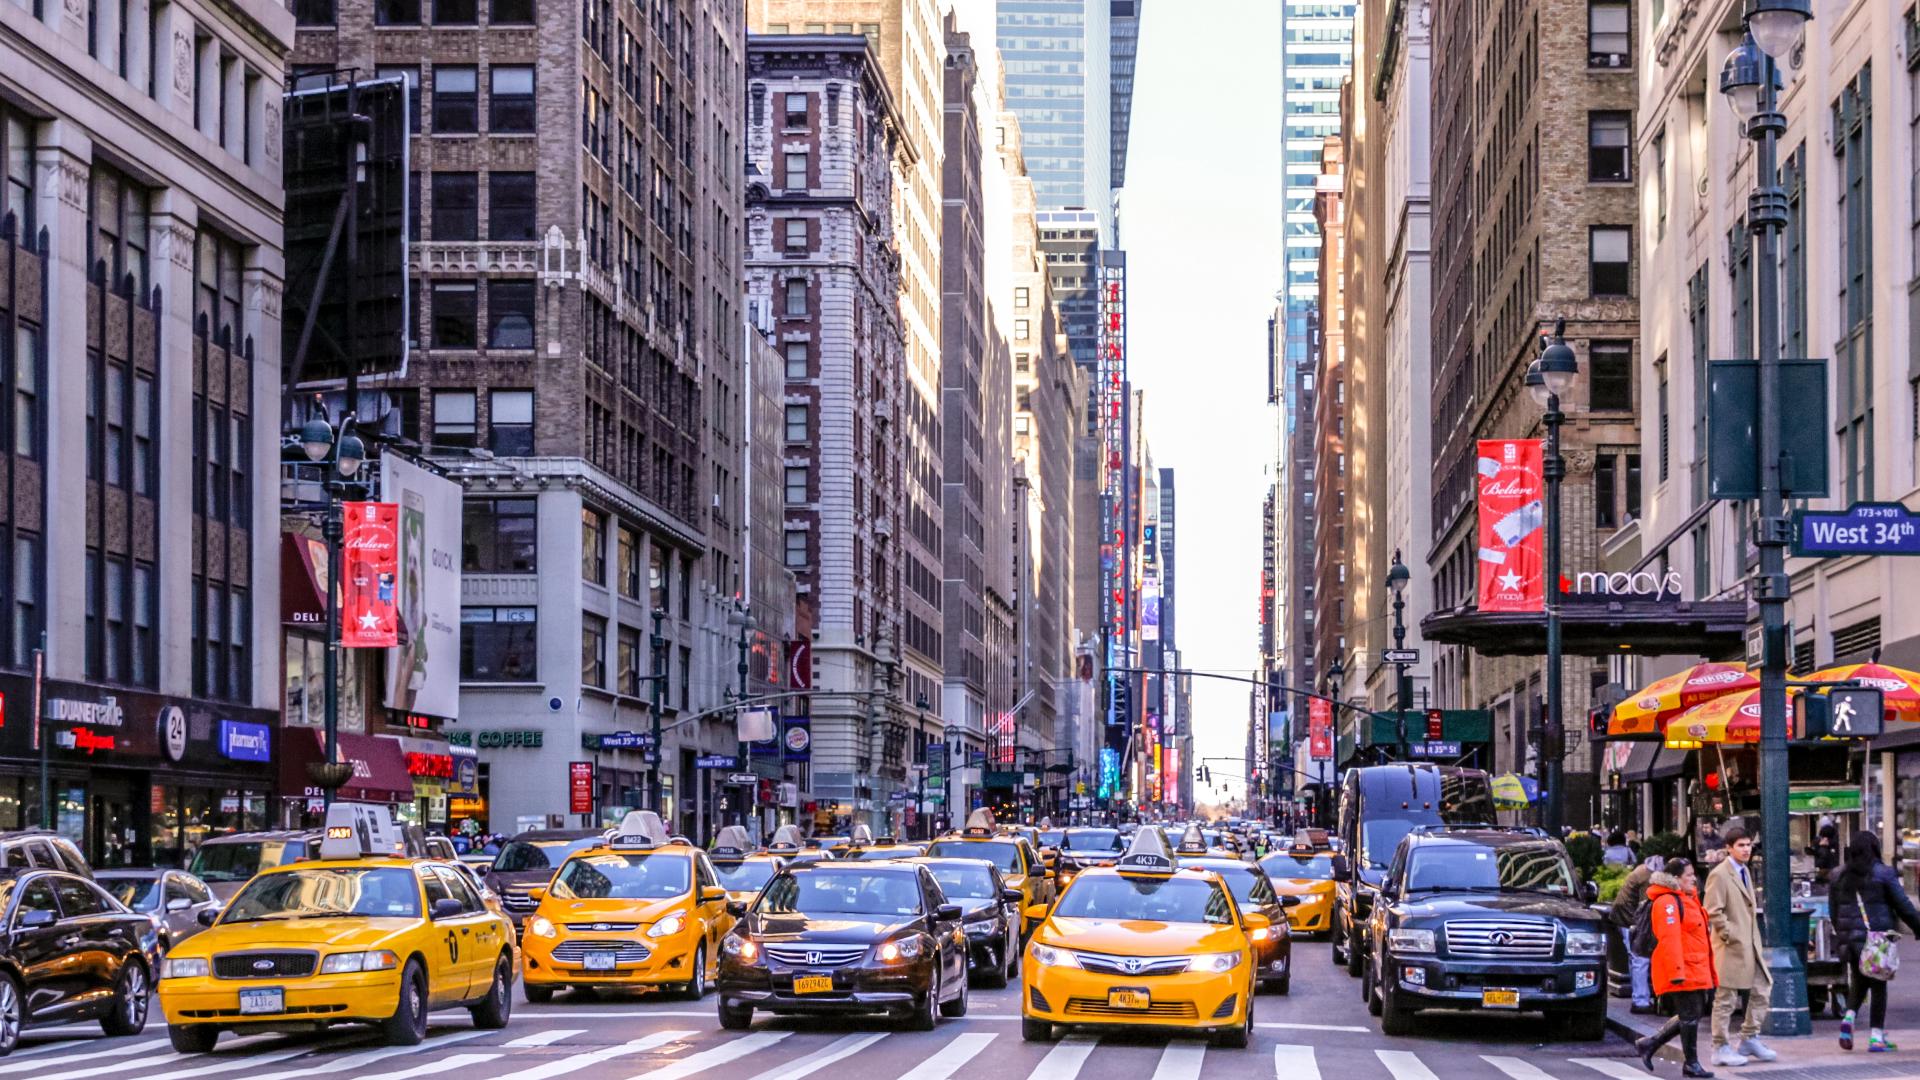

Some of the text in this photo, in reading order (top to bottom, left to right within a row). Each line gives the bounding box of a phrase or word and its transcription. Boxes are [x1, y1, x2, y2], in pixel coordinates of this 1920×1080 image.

[1481, 477, 1536, 496] Believe
[1857, 508, 1898, 517] 173 101
[1812, 521, 1914, 544] West 34th
[345, 533, 391, 549] Believe
[293, 612, 319, 621] DELI
[171, 716, 182, 739] 24
[478, 732, 543, 748] COFFEE
[604, 737, 621, 745] West
[328, 828, 351, 839] 2A31
[1135, 855, 1158, 865] 4K37
